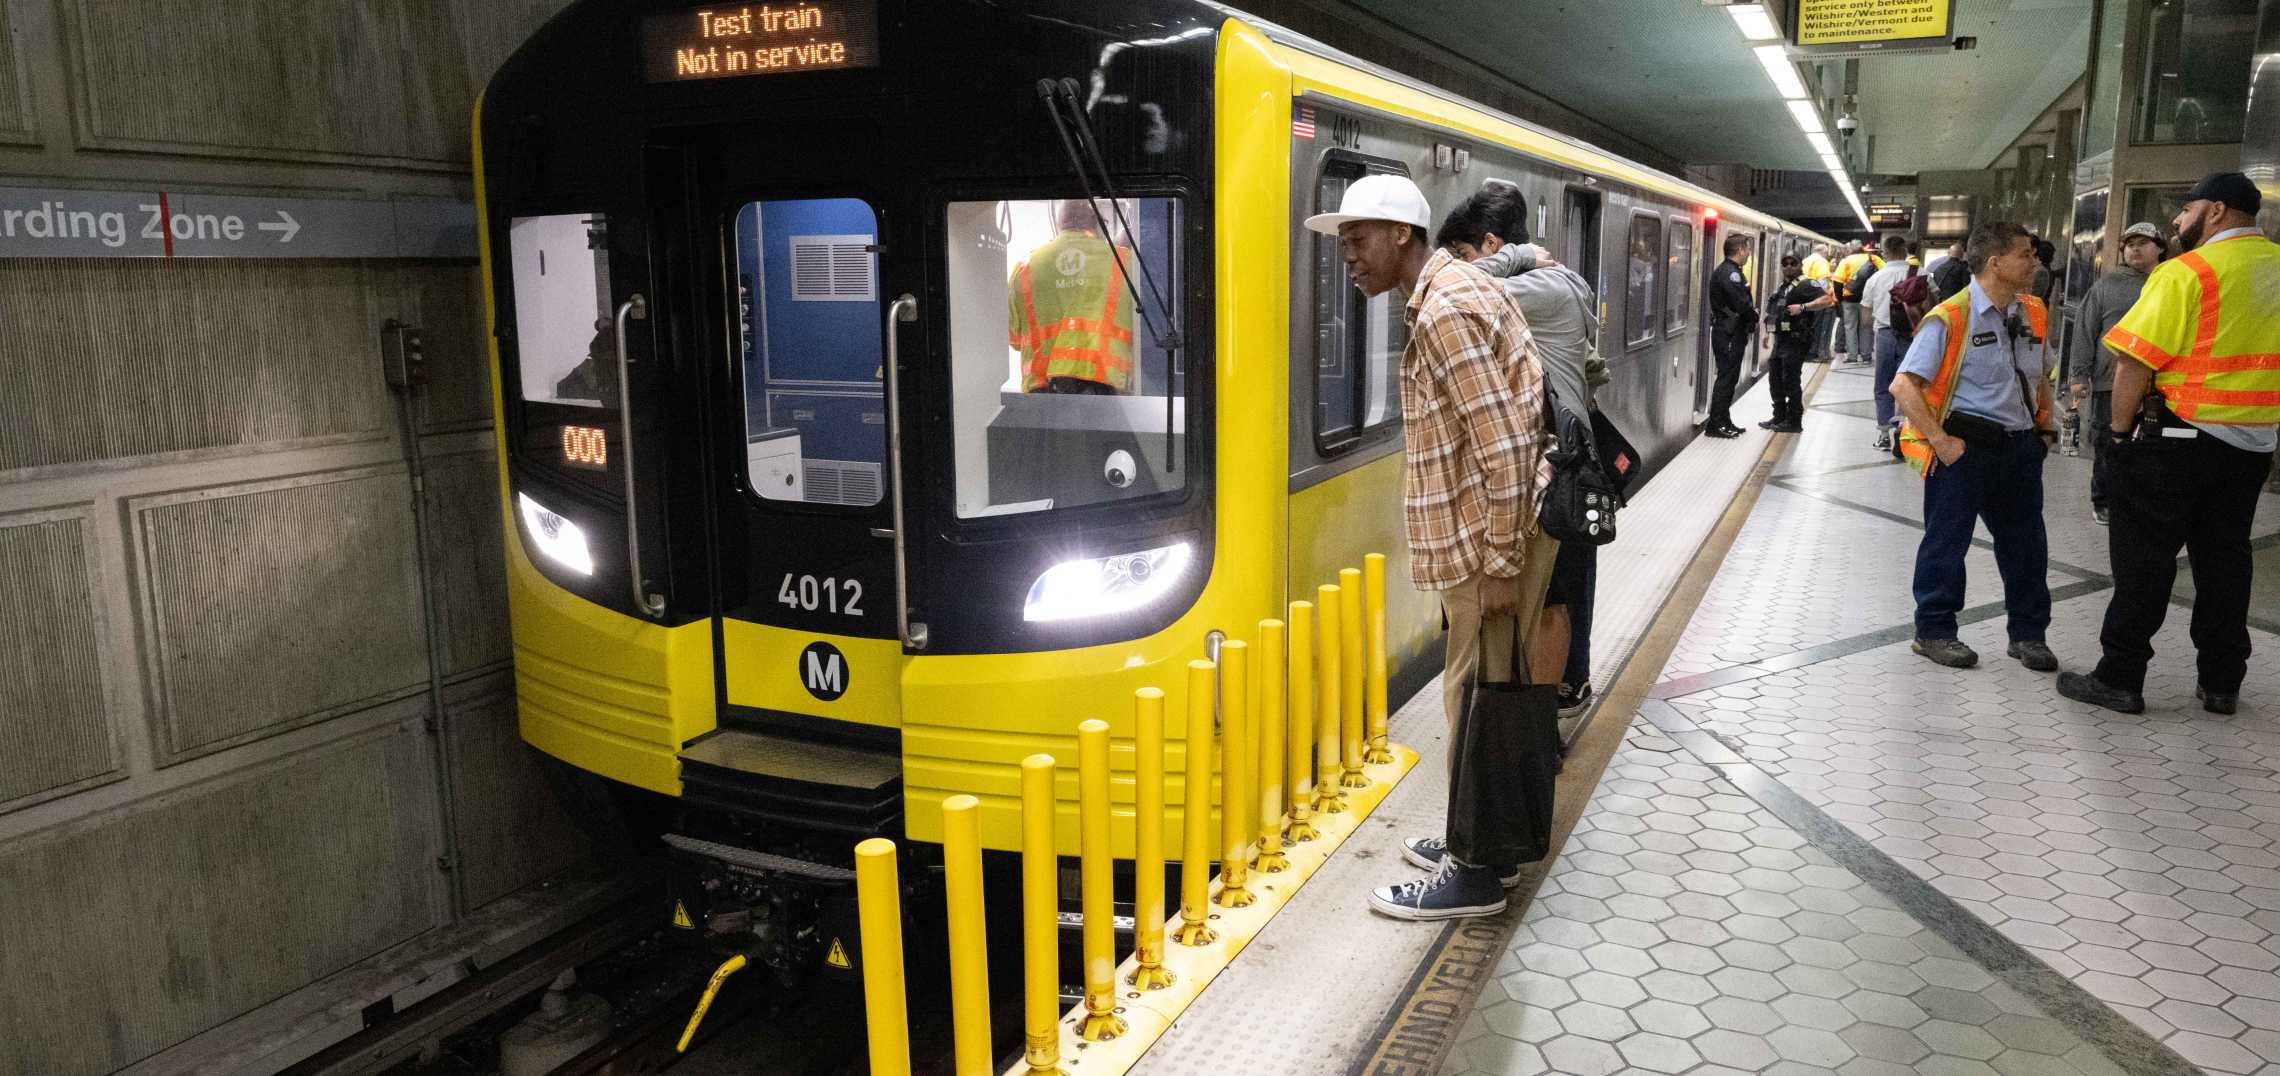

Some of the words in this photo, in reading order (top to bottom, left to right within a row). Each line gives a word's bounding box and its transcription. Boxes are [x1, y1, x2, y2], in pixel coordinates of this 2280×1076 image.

[698, 8, 752, 37] Test
[760, 3, 822, 32] train
[1804, 17, 1908, 30] Wilshire/Vermont
[1805, 3, 1847, 12] service
[1850, 1, 1875, 9] only
[1805, 8, 1908, 20] Wilshire/Western
[1911, 5, 1933, 13] and
[1818, 27, 1896, 38] maintenance.
[676, 47, 720, 75] Not
[726, 45, 748, 71] in
[756, 38, 845, 69] service
[1332, 114, 1361, 149] 4012
[0, 201, 126, 247] rding
[139, 204, 245, 241] Zone
[779, 572, 864, 616] 4012
[806, 649, 842, 693] M
